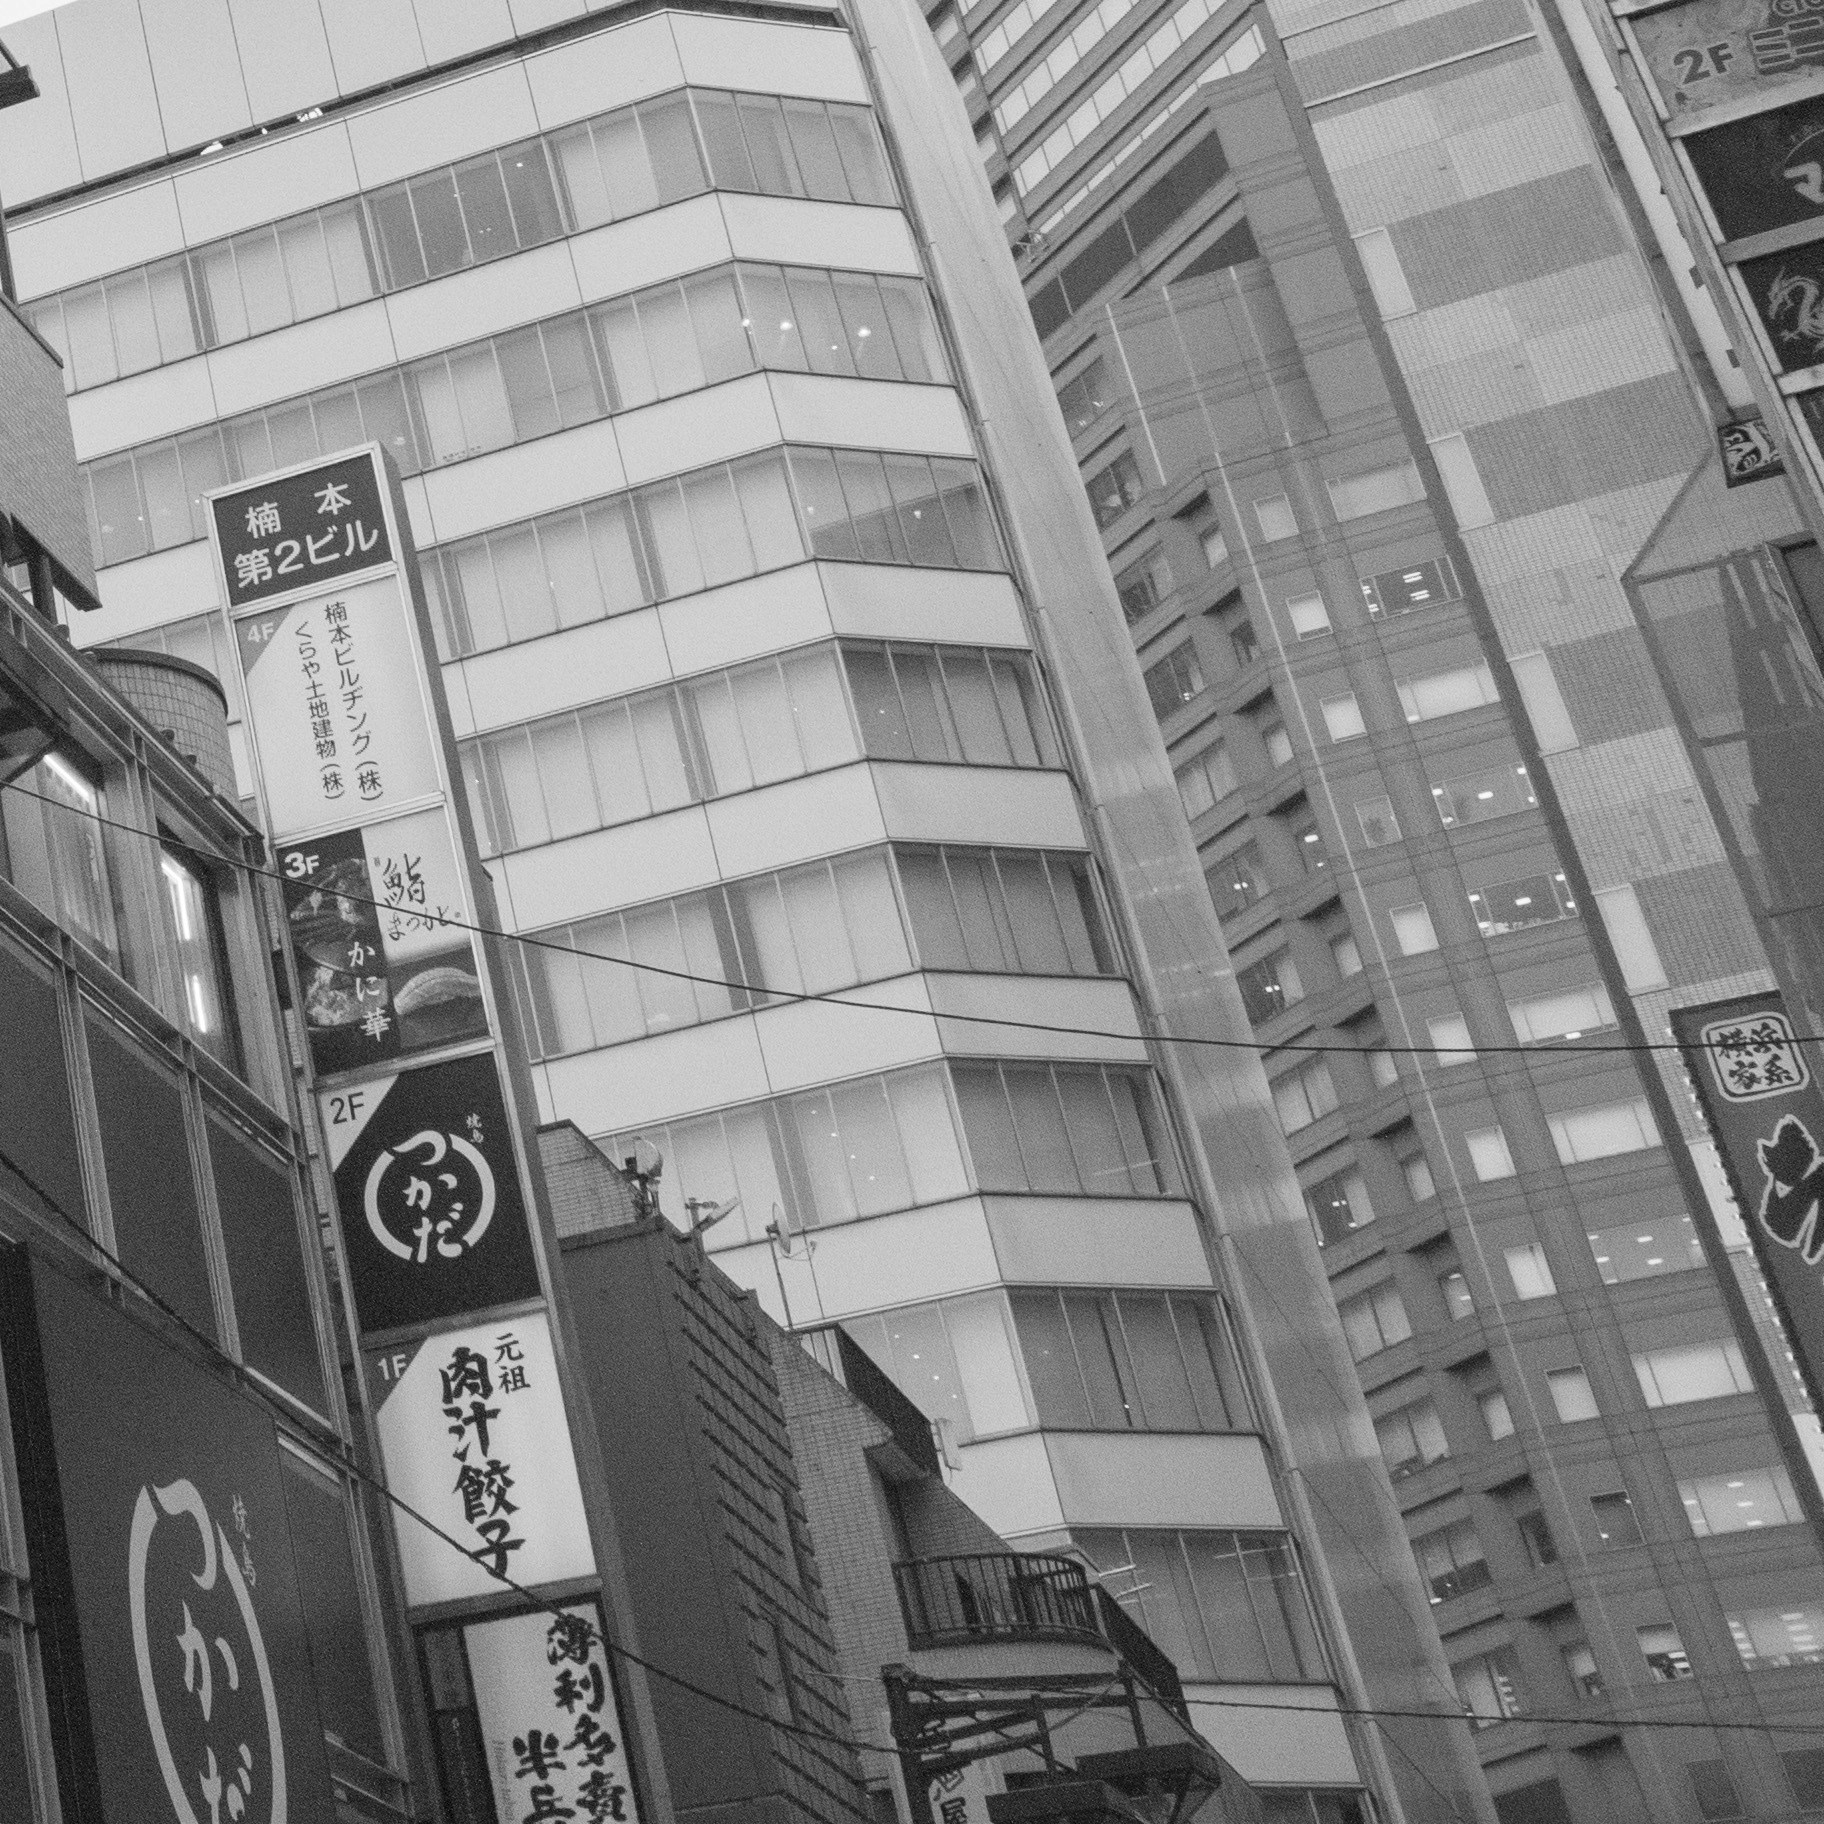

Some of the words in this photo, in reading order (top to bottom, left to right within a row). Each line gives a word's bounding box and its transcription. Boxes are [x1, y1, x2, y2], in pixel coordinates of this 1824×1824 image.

[1672, 42, 1734, 86] 2F
[232, 522, 380, 591] 第2ビル
[246, 620, 275, 646] 4F
[283, 851, 322, 879] 3F
[346, 940, 393, 1043] かに華
[329, 1093, 367, 1127] 2F
[390, 1128, 470, 1264] つかだ
[493, 1332, 531, 1395] 元祖
[438, 1347, 526, 1578] 肉汁餃子
